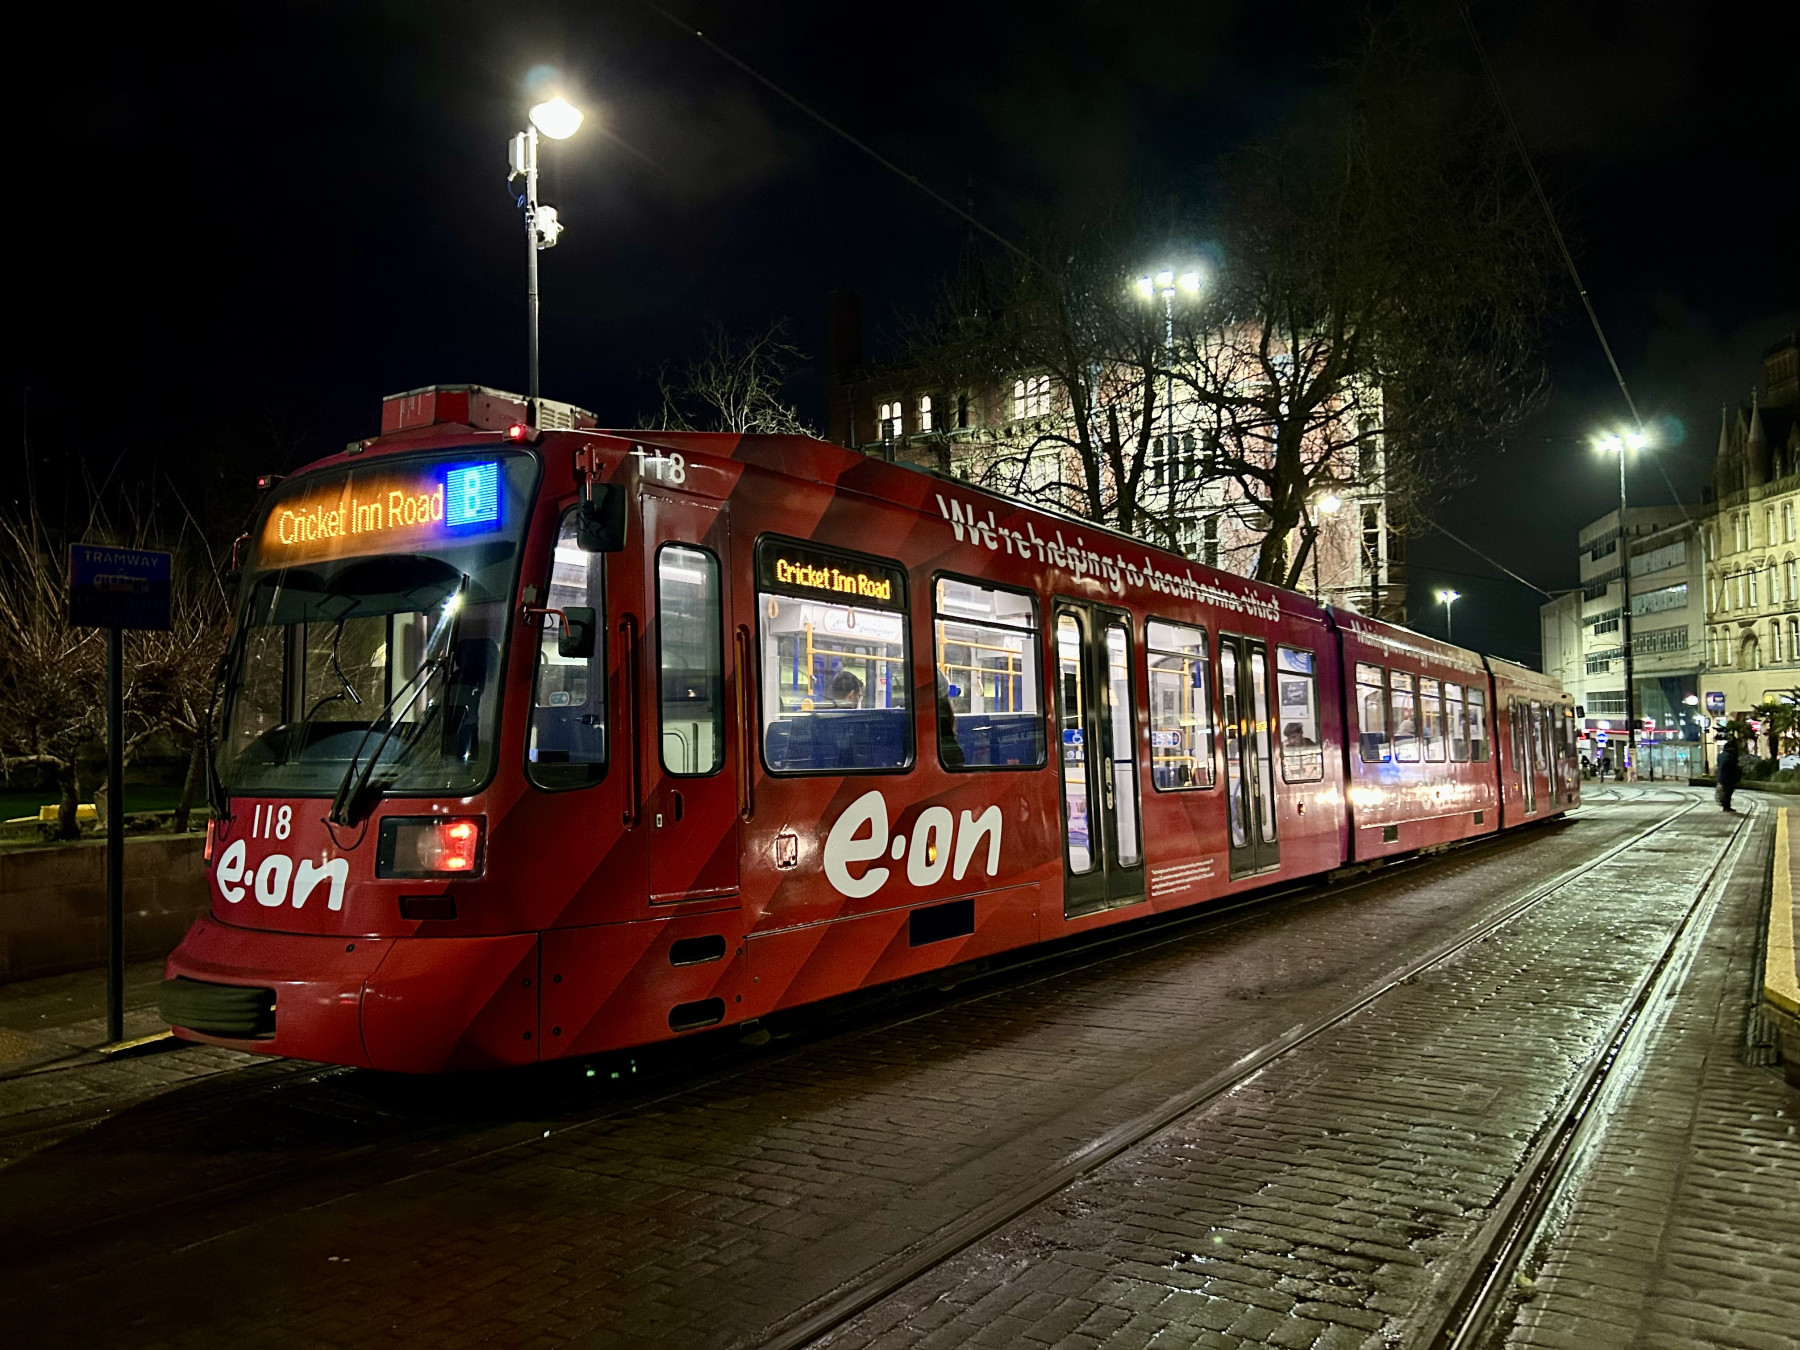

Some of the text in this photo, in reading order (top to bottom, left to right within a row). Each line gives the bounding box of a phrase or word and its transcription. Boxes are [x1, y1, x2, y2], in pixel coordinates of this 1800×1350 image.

[637, 445, 686, 484] 118
[279, 483, 443, 545] Cricket Inn Road
[84, 549, 159, 568] TRAMWAY
[935, 493, 1031, 559] We're
[1027, 521, 1122, 593] helping
[1118, 553, 1145, 588] to
[776, 558, 891, 600] Cricket Inn Road
[252, 804, 293, 840] 118
